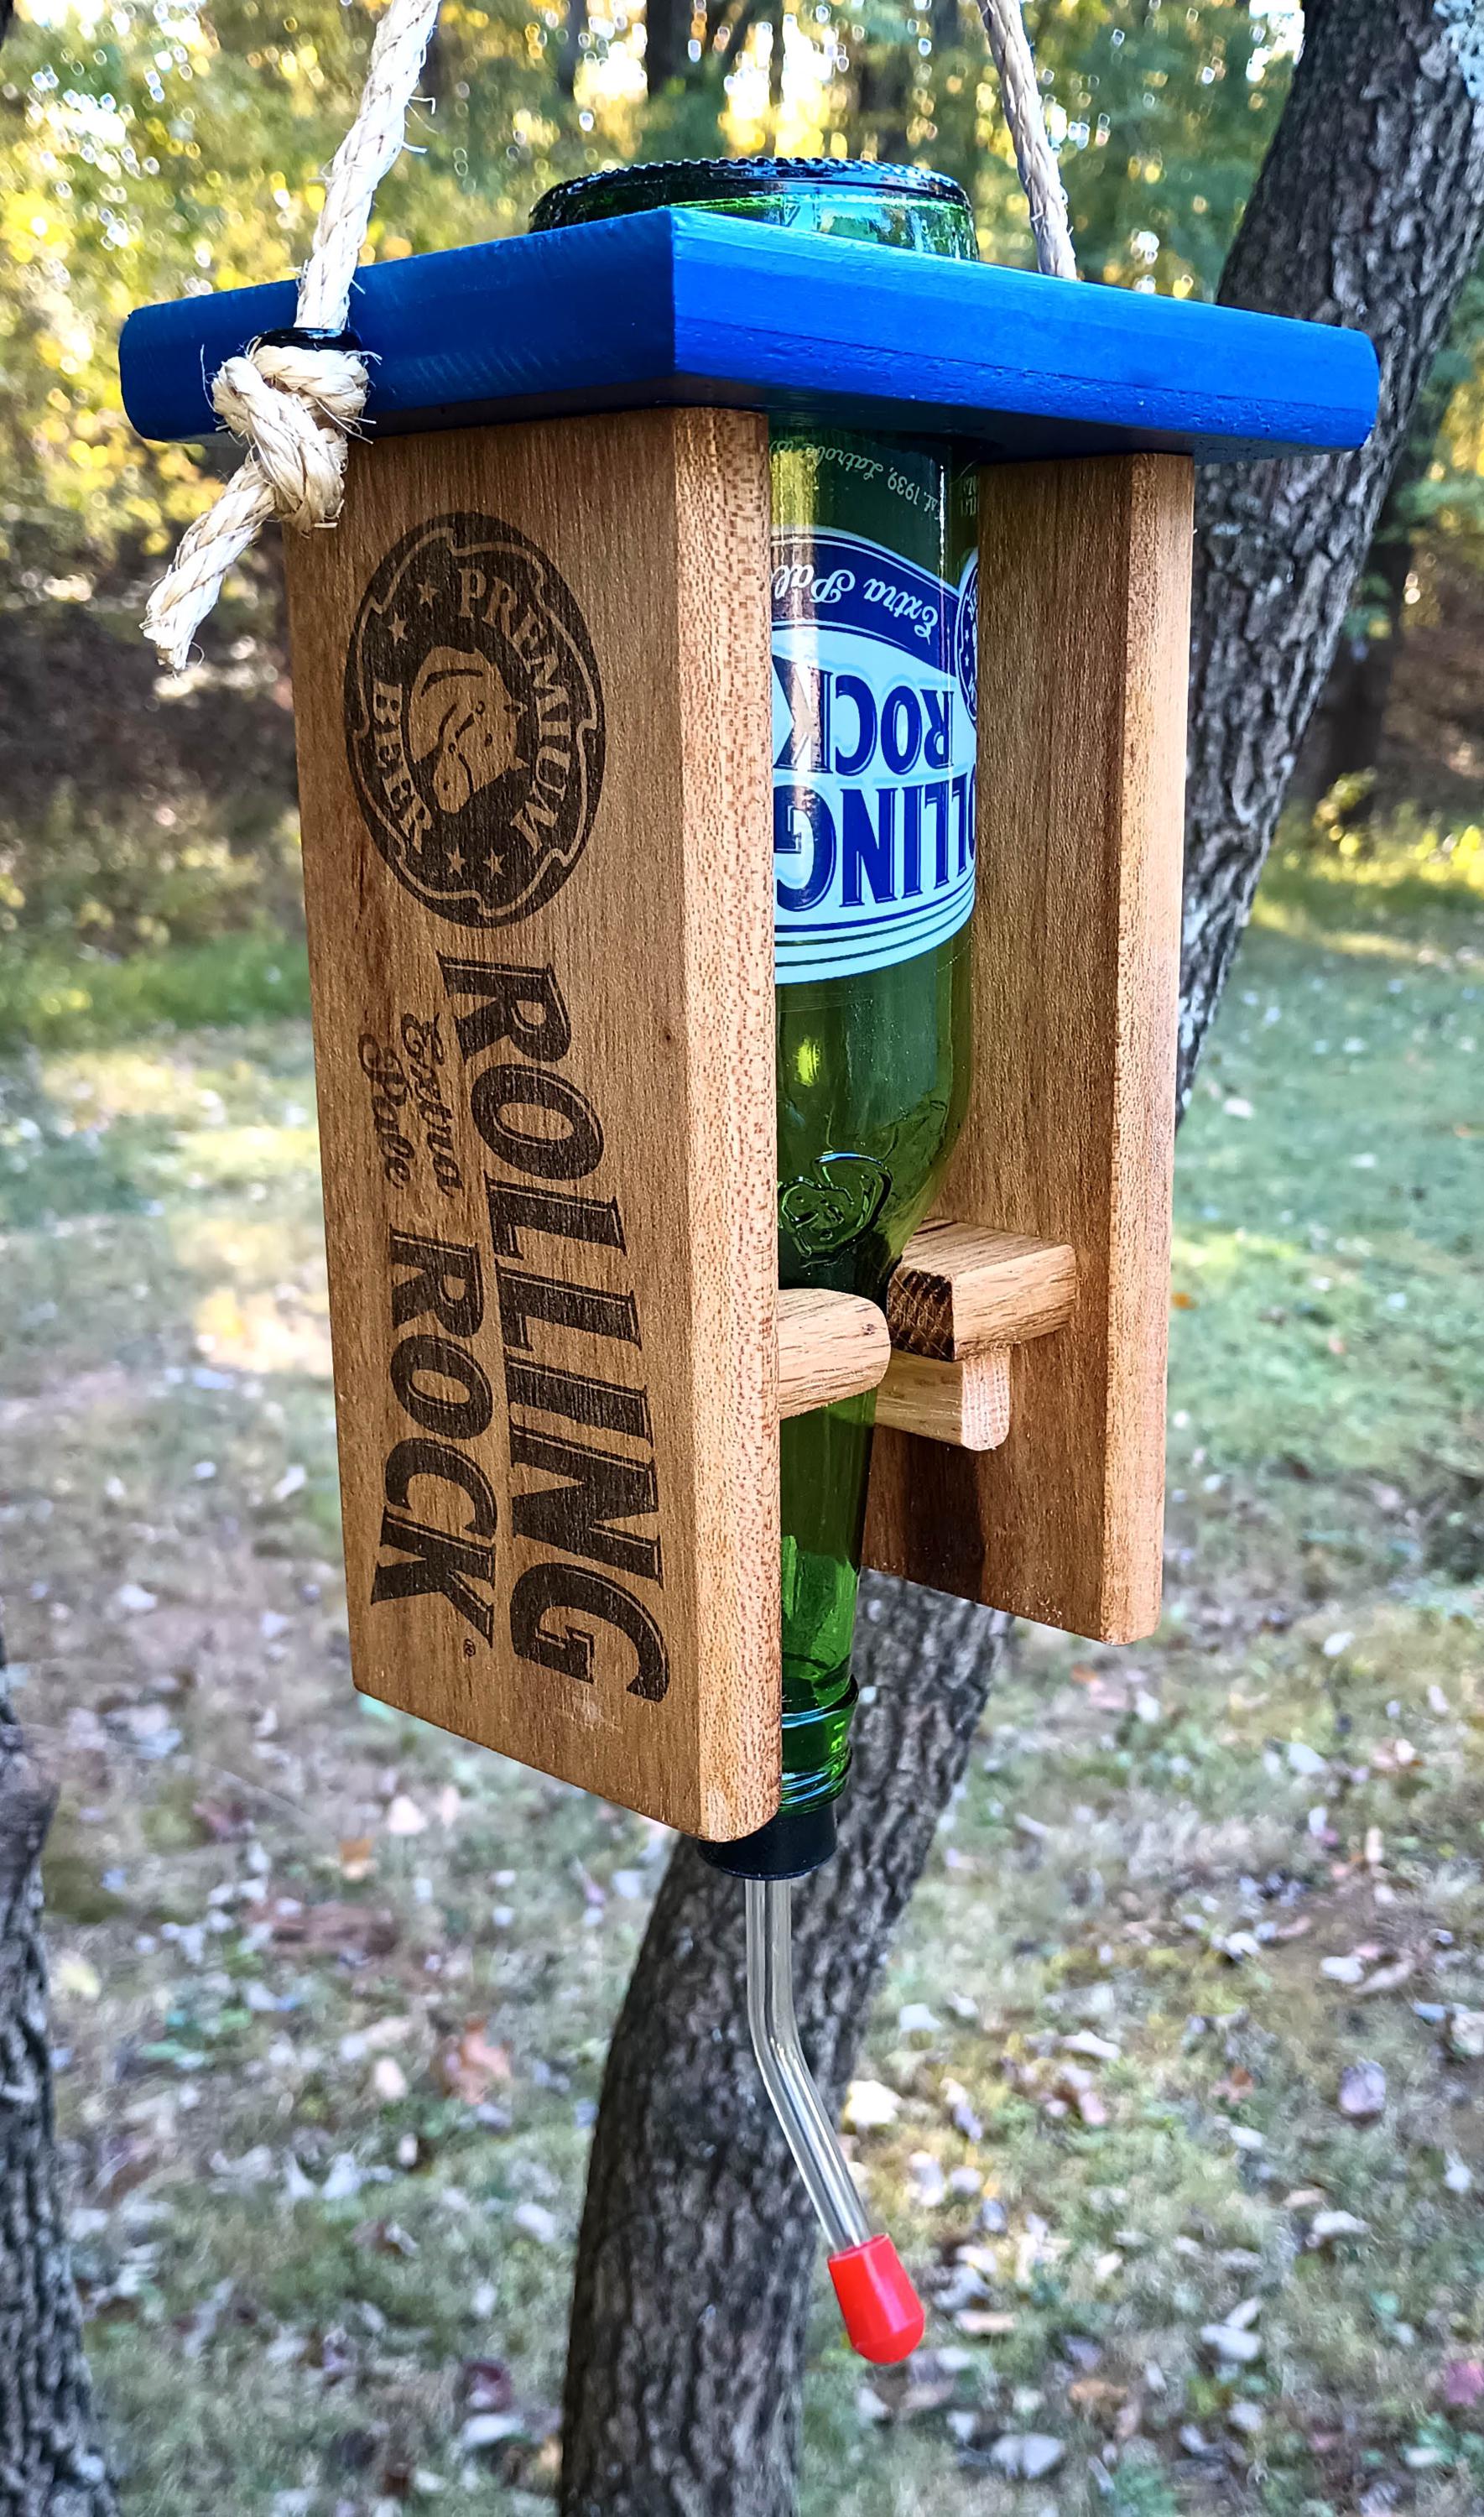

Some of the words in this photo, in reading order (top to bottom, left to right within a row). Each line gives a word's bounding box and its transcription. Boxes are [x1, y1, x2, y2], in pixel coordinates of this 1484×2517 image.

[803, 442, 884, 481] Latrobe
[888, 461, 919, 505] 1939,
[770, 563, 856, 604] Pal
[863, 577, 939, 645] Extra
[372, 681, 433, 855] BEER
[457, 567, 571, 855] PREMIUM
[772, 658, 954, 777] ROCK
[357, 1033, 416, 1191] Pale
[398, 1010, 464, 1199] Extra
[435, 951, 670, 1702] ROLLING
